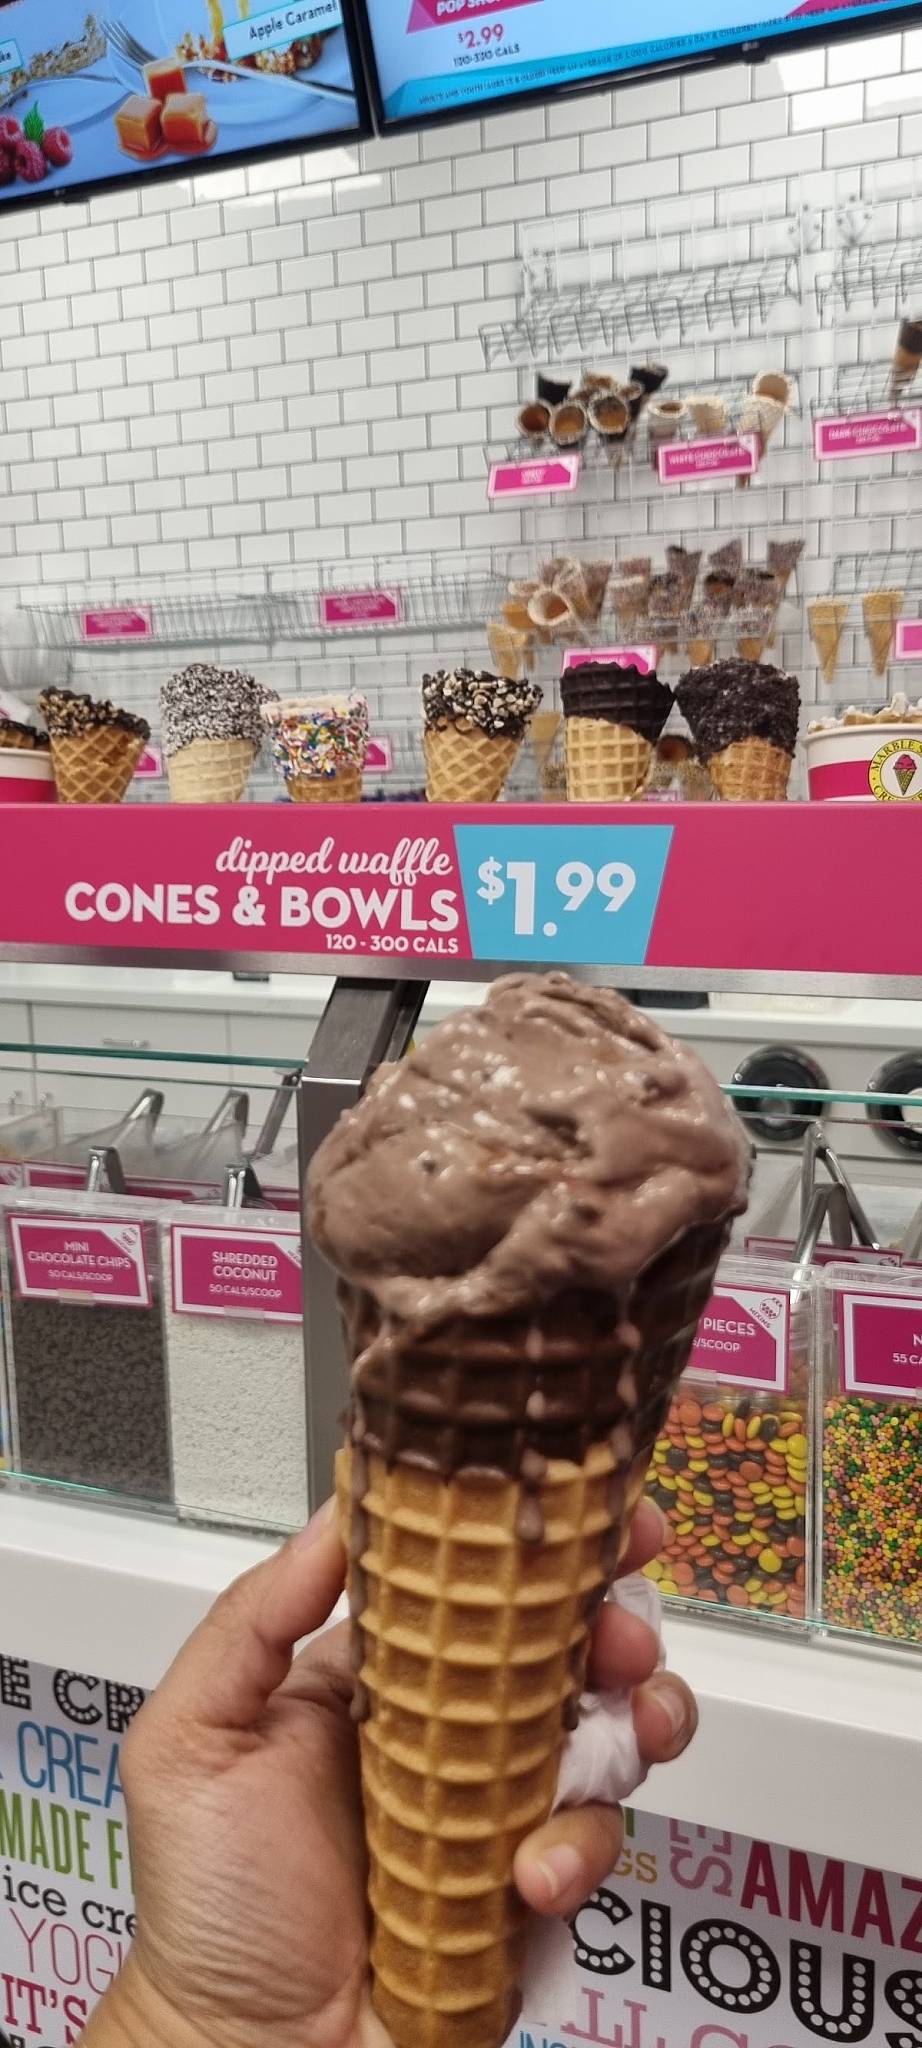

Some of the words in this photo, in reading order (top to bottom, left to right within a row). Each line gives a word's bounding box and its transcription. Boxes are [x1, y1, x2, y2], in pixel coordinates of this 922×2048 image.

[249, 16, 283, 40] Apple
[285, 2, 337, 26] Caramel
[457, 24, 504, 48] $2.99
[215, 836, 335, 885] dipped
[338, 837, 453, 887] waffle
[64, 881, 221, 926] CONES
[232, 885, 266, 926] &
[280, 886, 459, 932] BOWLS
[477, 857, 636, 938] $1.99
[326, 934, 356, 950] 120
[370, 935, 409, 952] 300
[412, 937, 459, 954] CALS
[64, 1241, 90, 1253] MINI
[28, 1252, 96, 1268] CHOCOLATE
[97, 1255, 132, 1270] CHIPS
[212, 1251, 279, 1268] SHREDDED
[48, 1269, 60, 1279] 50
[61, 1270, 114, 1282] CALS/SCOOP
[213, 1265, 278, 1282] COCONUT
[209, 1283, 223, 1295] 50
[224, 1284, 283, 1299] CALS/SCOOP
[703, 1317, 756, 1336] PIECES
[892, 1352, 907, 1364] 55
[0, 1789, 95, 1882] MADE
[3, 1864, 67, 1917] ice
